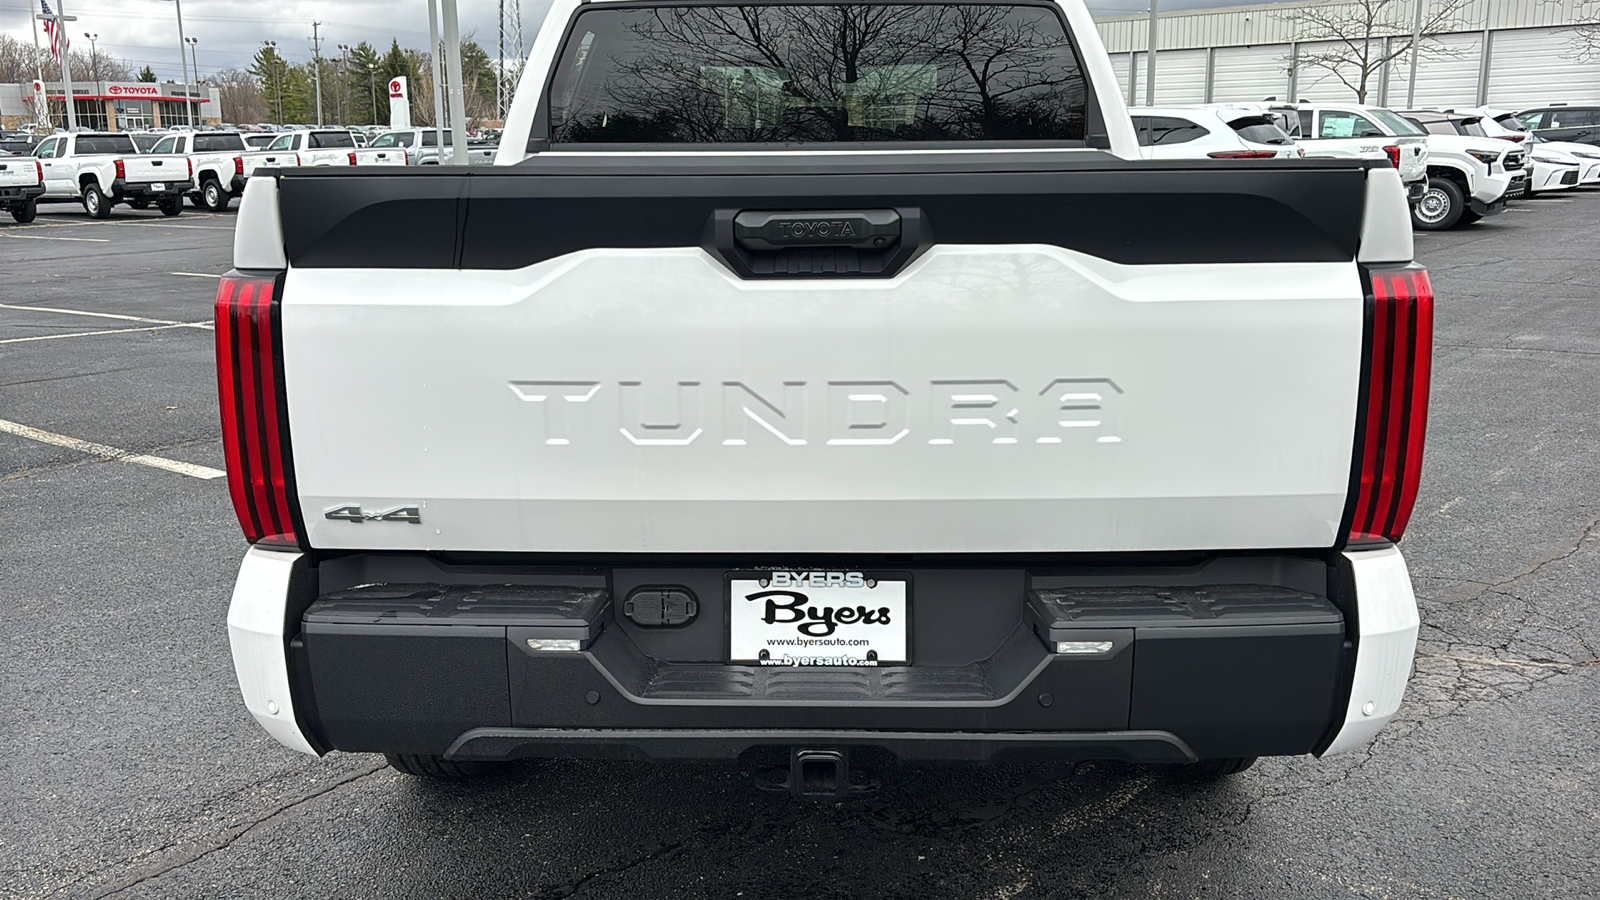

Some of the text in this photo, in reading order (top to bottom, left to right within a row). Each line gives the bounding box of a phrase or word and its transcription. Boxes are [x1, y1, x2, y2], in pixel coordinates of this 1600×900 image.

[779, 221, 856, 238] TOYOTA
[508, 378, 1125, 445] TUNDRA
[771, 571, 865, 588] BYERS
[744, 590, 891, 637] Byers
[766, 637, 870, 647] www.byersauto.com
[760, 653, 878, 667] www.byersauto.com
